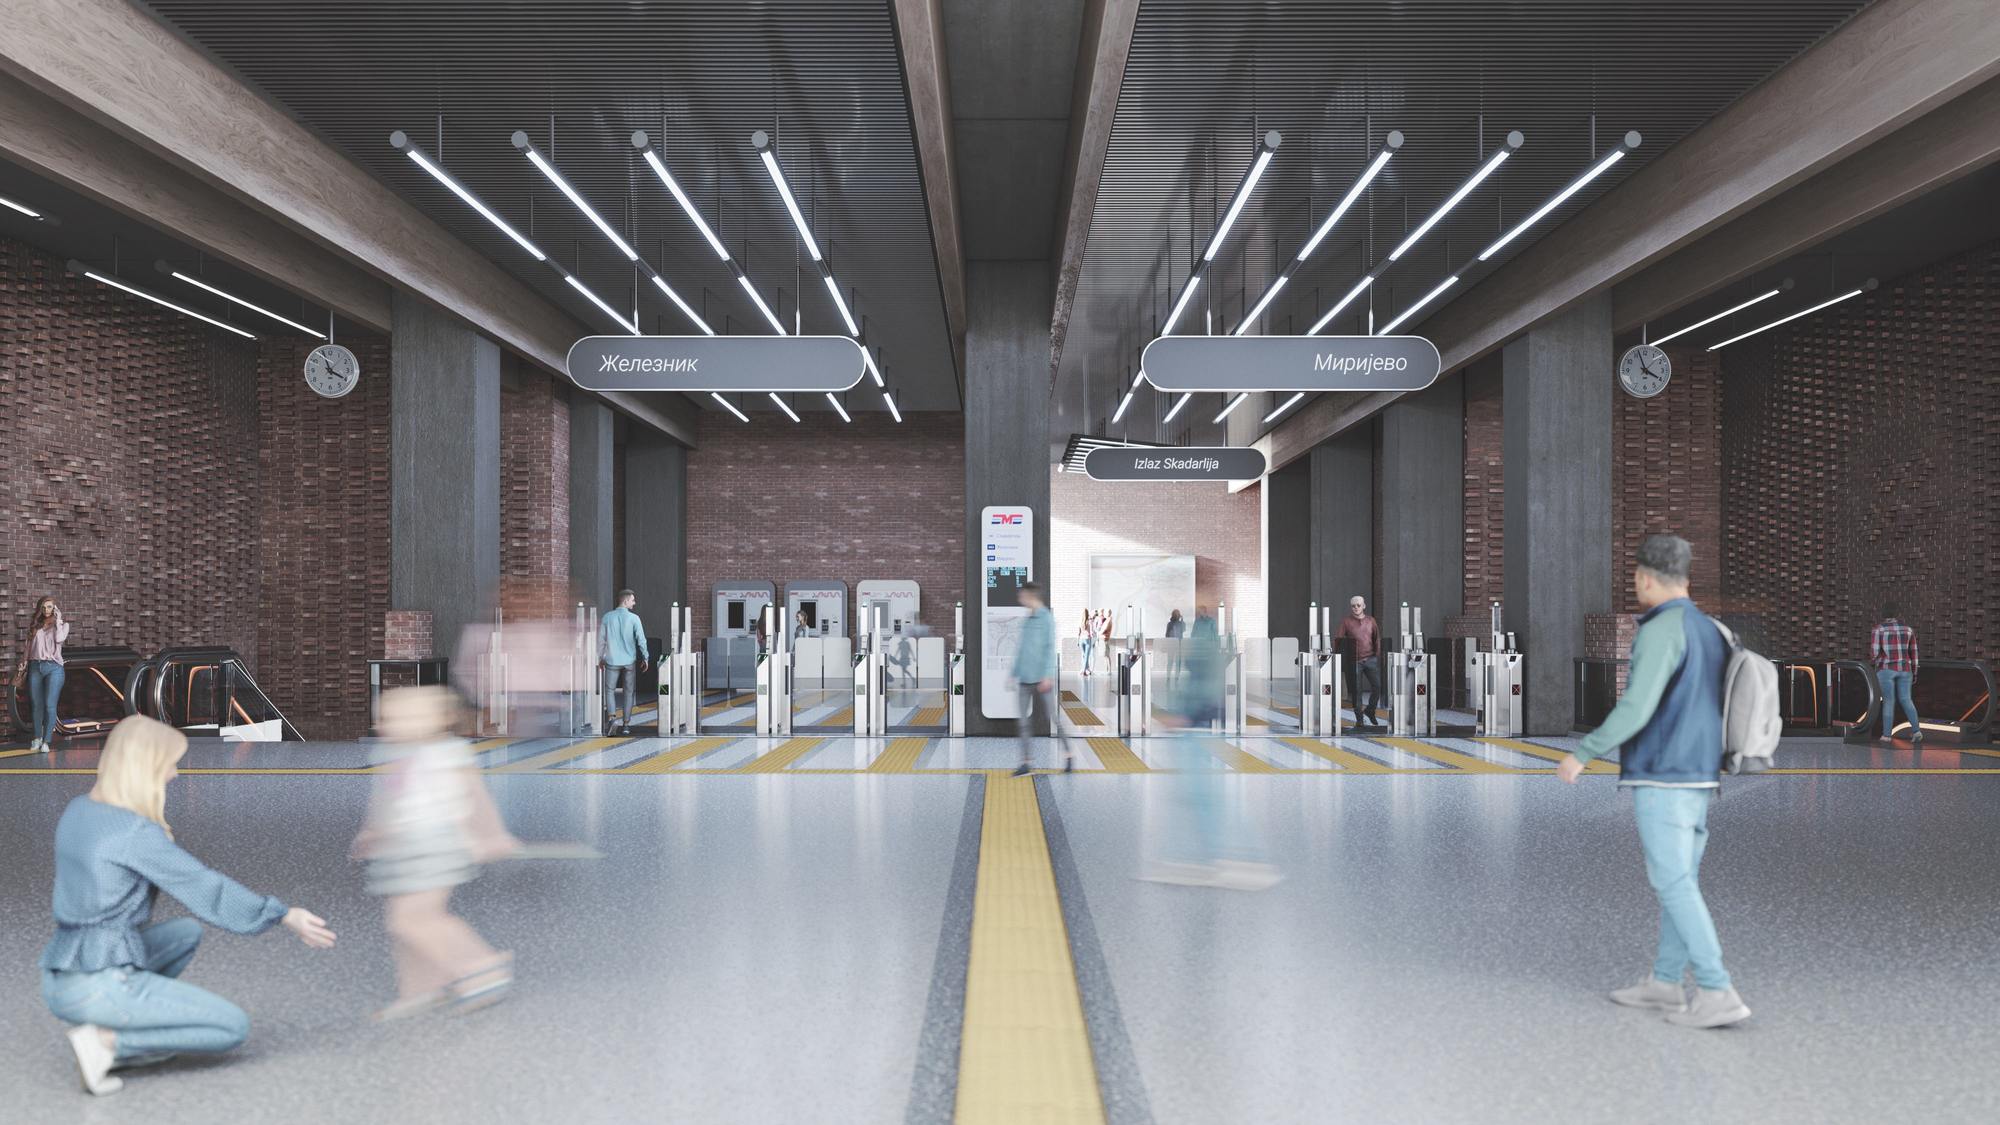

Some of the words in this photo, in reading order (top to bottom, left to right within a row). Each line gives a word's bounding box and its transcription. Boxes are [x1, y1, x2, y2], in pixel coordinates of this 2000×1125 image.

[598, 354, 699, 372] Железник
[1313, 353, 1408, 375] Миријево
[1134, 458, 1162, 470] Izlaz
[1163, 458, 1219, 472] Skadarlija
